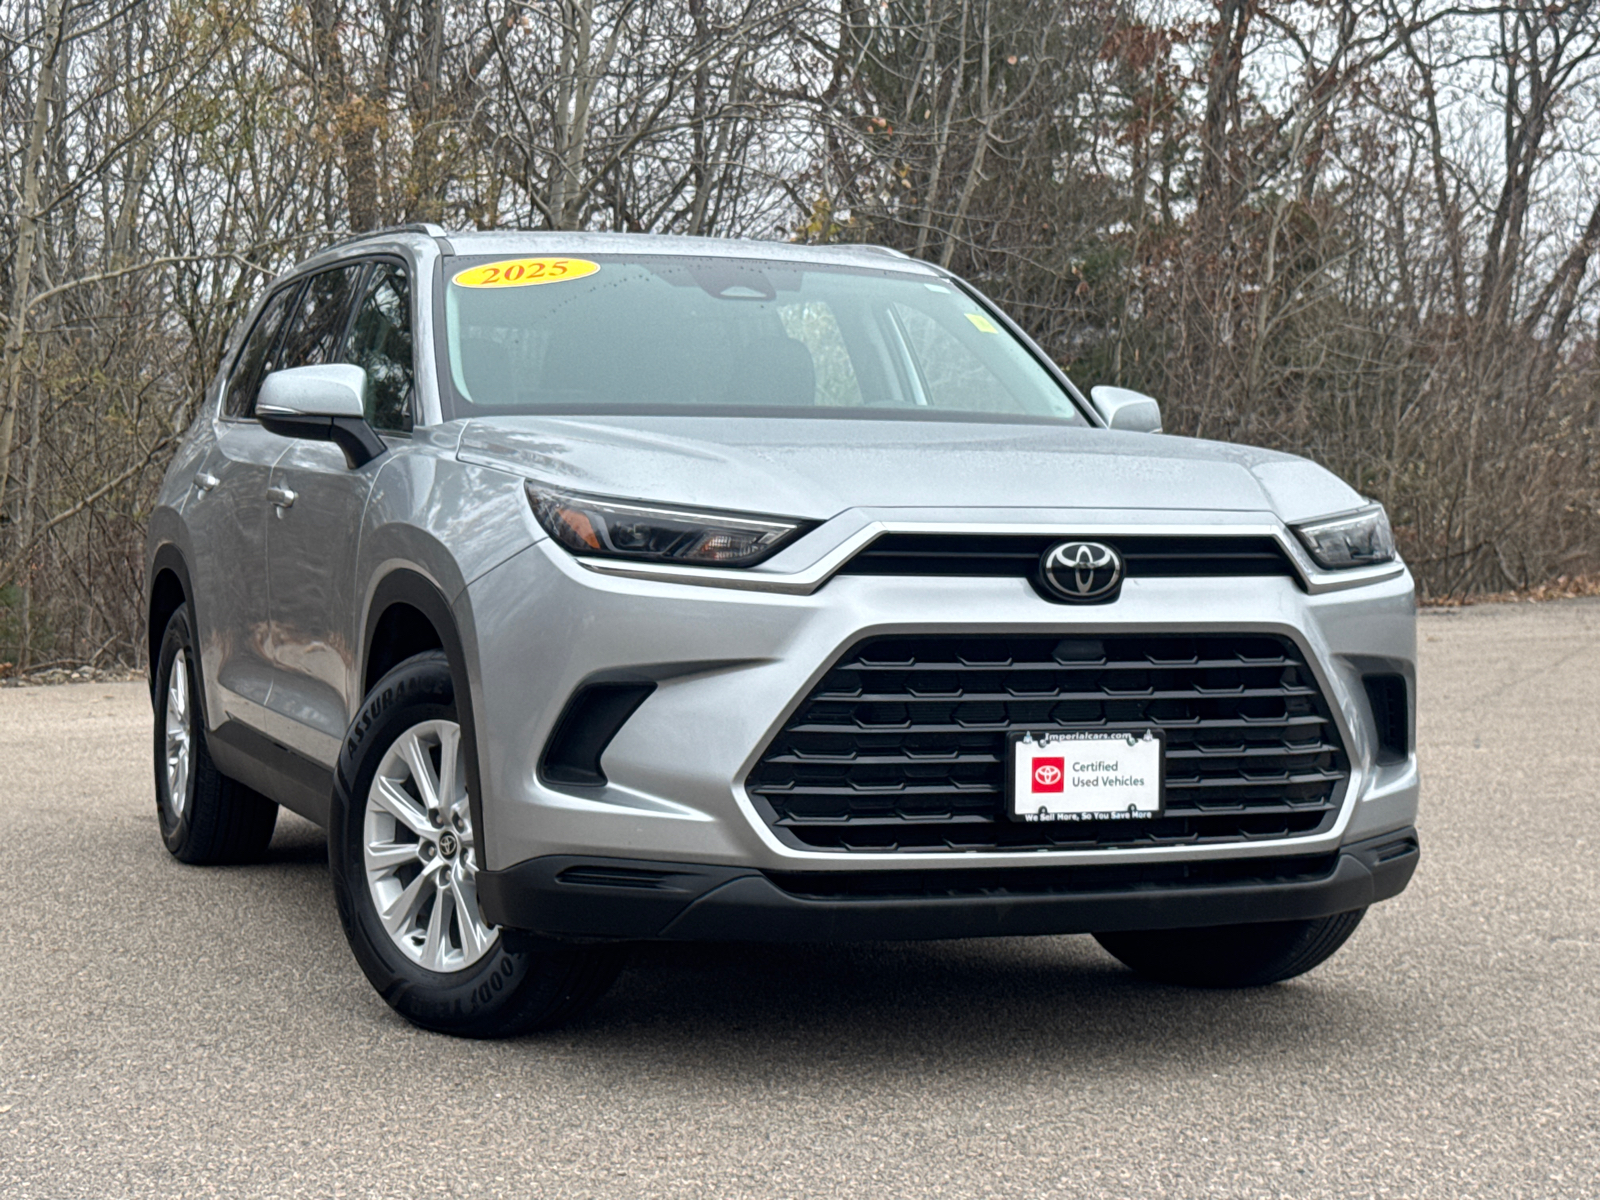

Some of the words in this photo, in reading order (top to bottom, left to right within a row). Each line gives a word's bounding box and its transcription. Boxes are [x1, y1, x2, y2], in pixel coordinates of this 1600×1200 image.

[481, 260, 569, 285] 2025
[1072, 761, 1119, 772] Certified
[1072, 777, 1099, 787] Used
[1101, 775, 1145, 787] Vehicles
[1025, 814, 1039, 822] We
[1040, 813, 1055, 821] Sell
[1057, 812, 1080, 821] More,
[1081, 812, 1092, 820] So
[1093, 811, 1109, 820] You
[1110, 811, 1131, 820] Save
[1131, 810, 1152, 819] More
